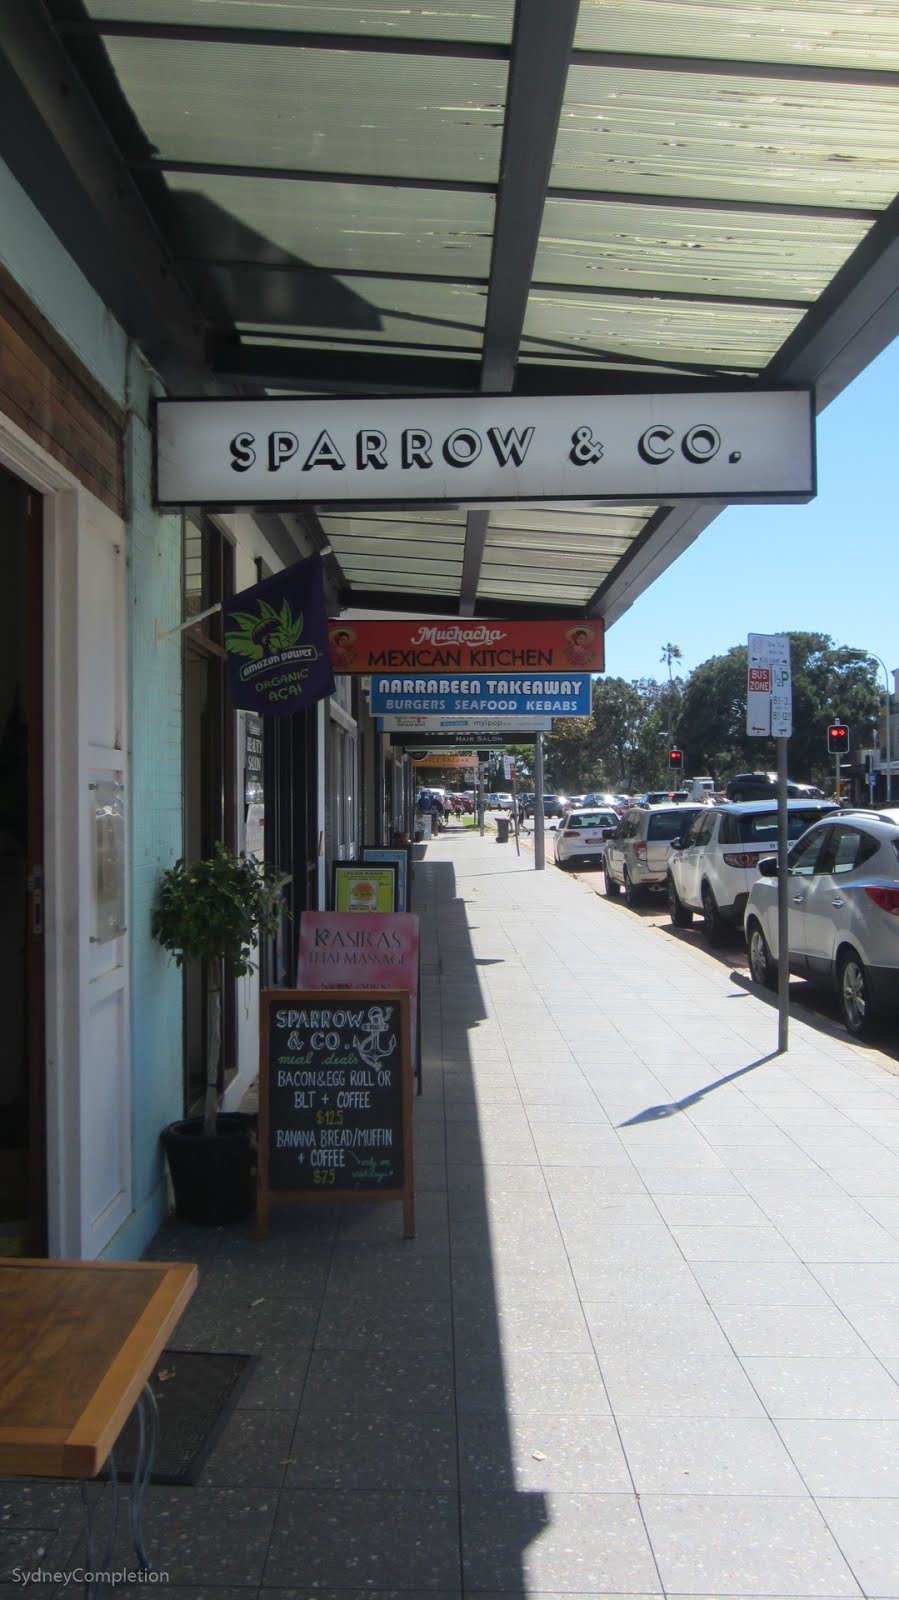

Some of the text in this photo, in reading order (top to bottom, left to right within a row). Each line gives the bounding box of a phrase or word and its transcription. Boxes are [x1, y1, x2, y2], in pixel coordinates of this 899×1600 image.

[229, 423, 742, 472] SPARROW & CO.
[411, 625, 507, 647] Muchacha
[243, 648, 313, 677] amazon power
[368, 649, 553, 668] MEXICAN KITCHEN
[255, 668, 309, 692] ORGANIC
[751, 670, 767, 679] BUS
[378, 680, 582, 695] NARRABEEN TAKEAWAY
[749, 681, 769, 691] ZONE
[386, 700, 578, 711] BURGERS SEAFOOD KEBABS
[247, 737, 262, 754] BEAUTY
[247, 755, 261, 771] SALON
[315, 928, 401, 948] KASIRAS
[309, 951, 406, 965] THAI MASSAGE
[276, 1009, 364, 1029] SPARROW
[287, 1031, 350, 1050] & CO.
[277, 1052, 359, 1065] meal deals
[277, 1070, 391, 1087] BACON&EGG ROLL OR
[294, 1091, 371, 1109] BLT + COFFEE
[276, 1128, 393, 1147] BANANA BREAD/MUFFIN
[298, 1149, 346, 1167] + COFFEE
